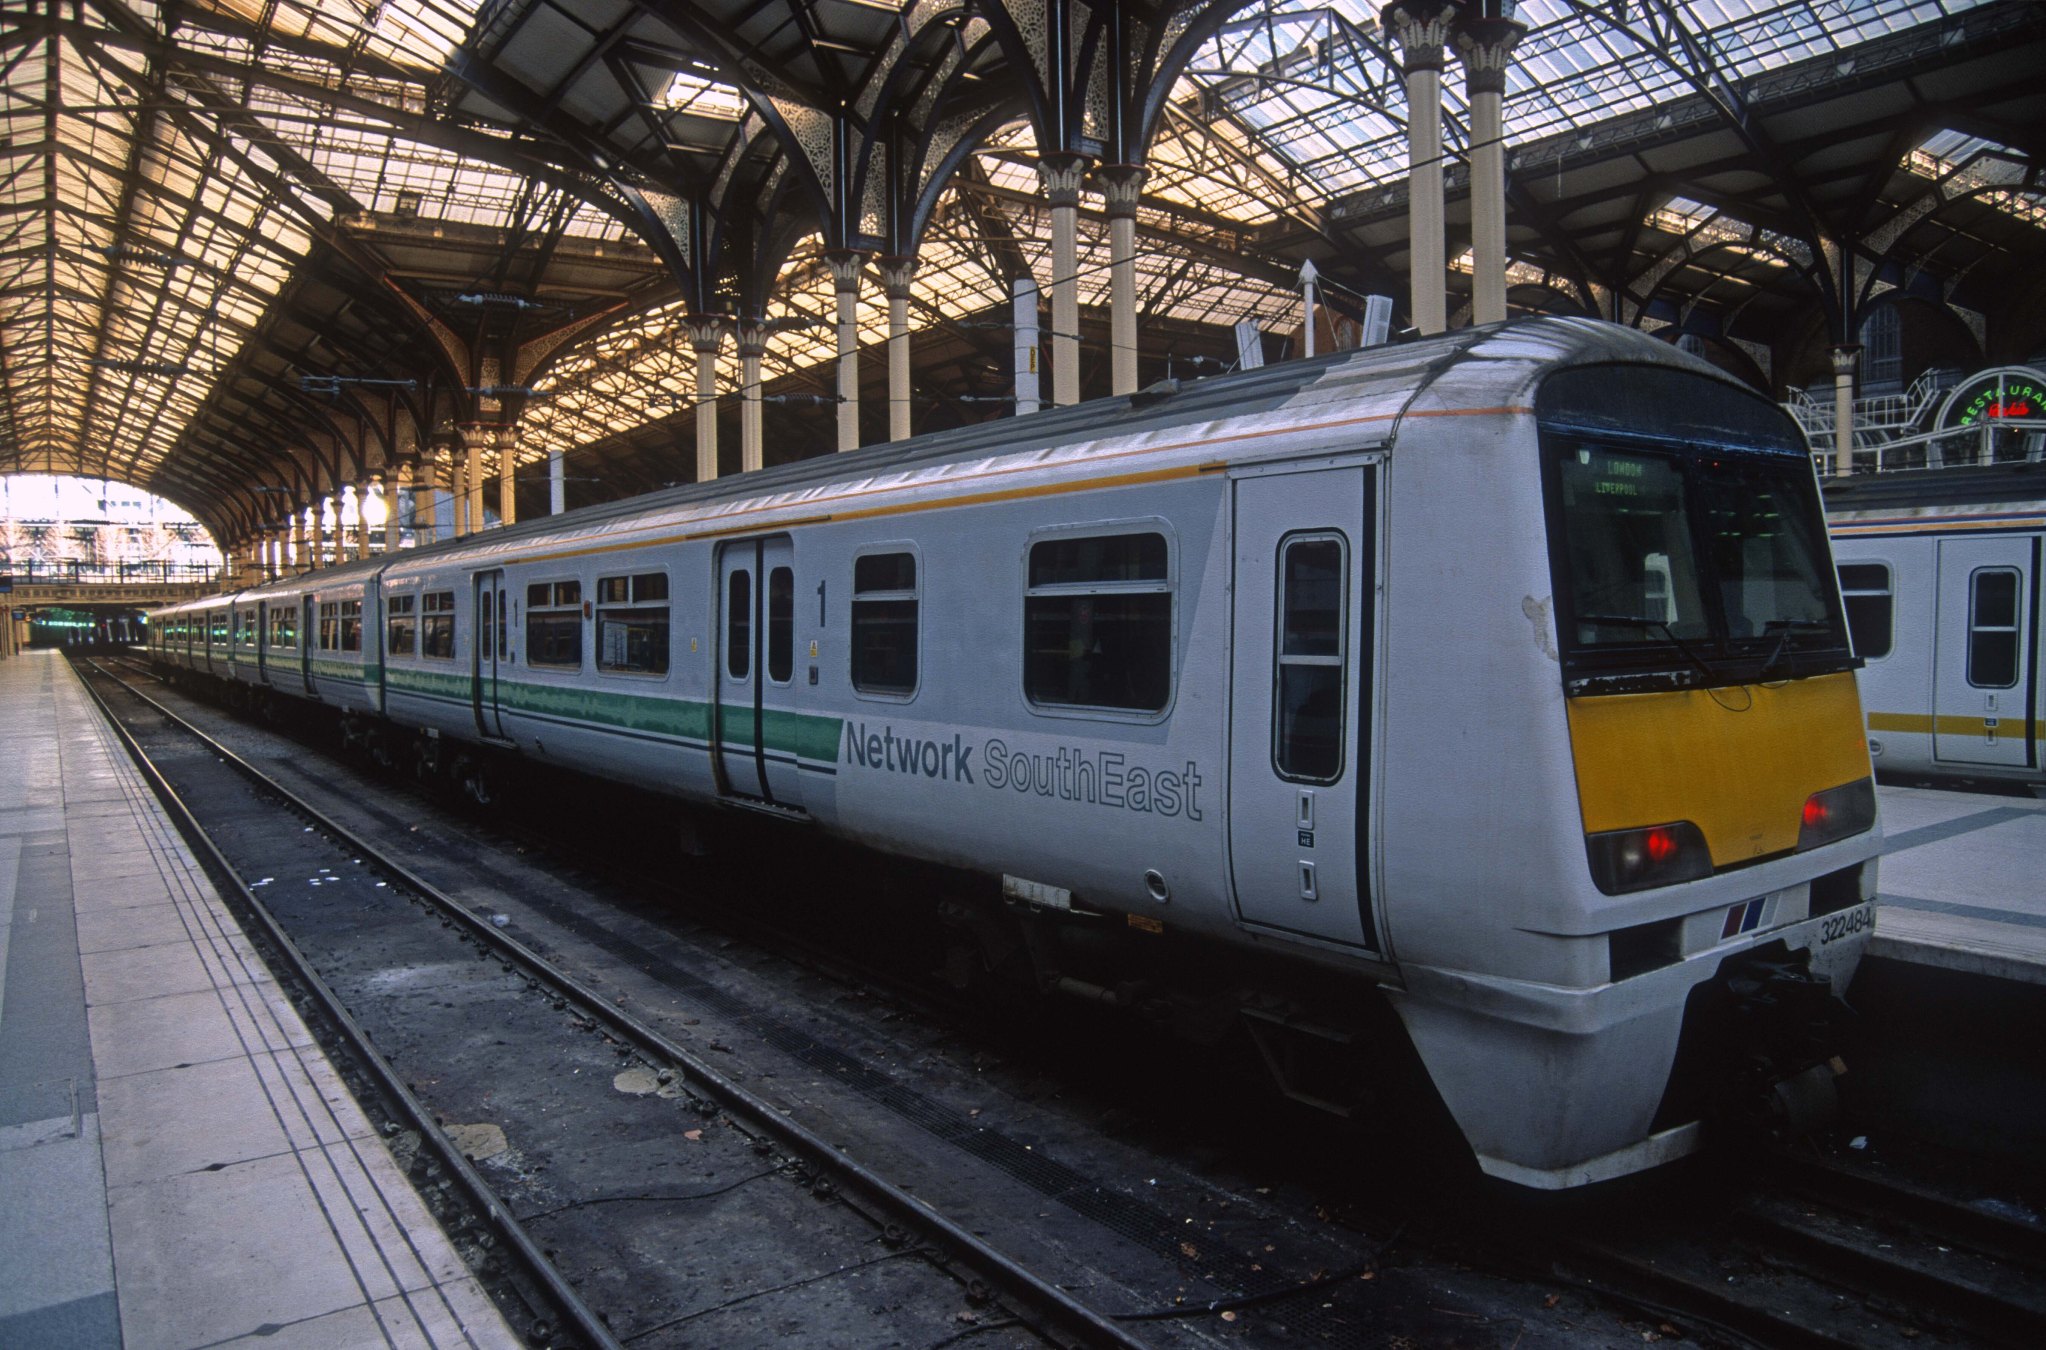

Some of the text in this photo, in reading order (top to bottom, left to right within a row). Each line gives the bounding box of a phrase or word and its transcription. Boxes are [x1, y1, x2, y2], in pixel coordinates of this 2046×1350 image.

[1607, 460, 1643, 476] LONDON
[1595, 481, 1638, 496] LIVERPOOL
[817, 580, 826, 627] 1
[846, 721, 1203, 822] Network SouthEast
[1301, 837, 1311, 846] HE
[1820, 906, 1872, 945] 322484
